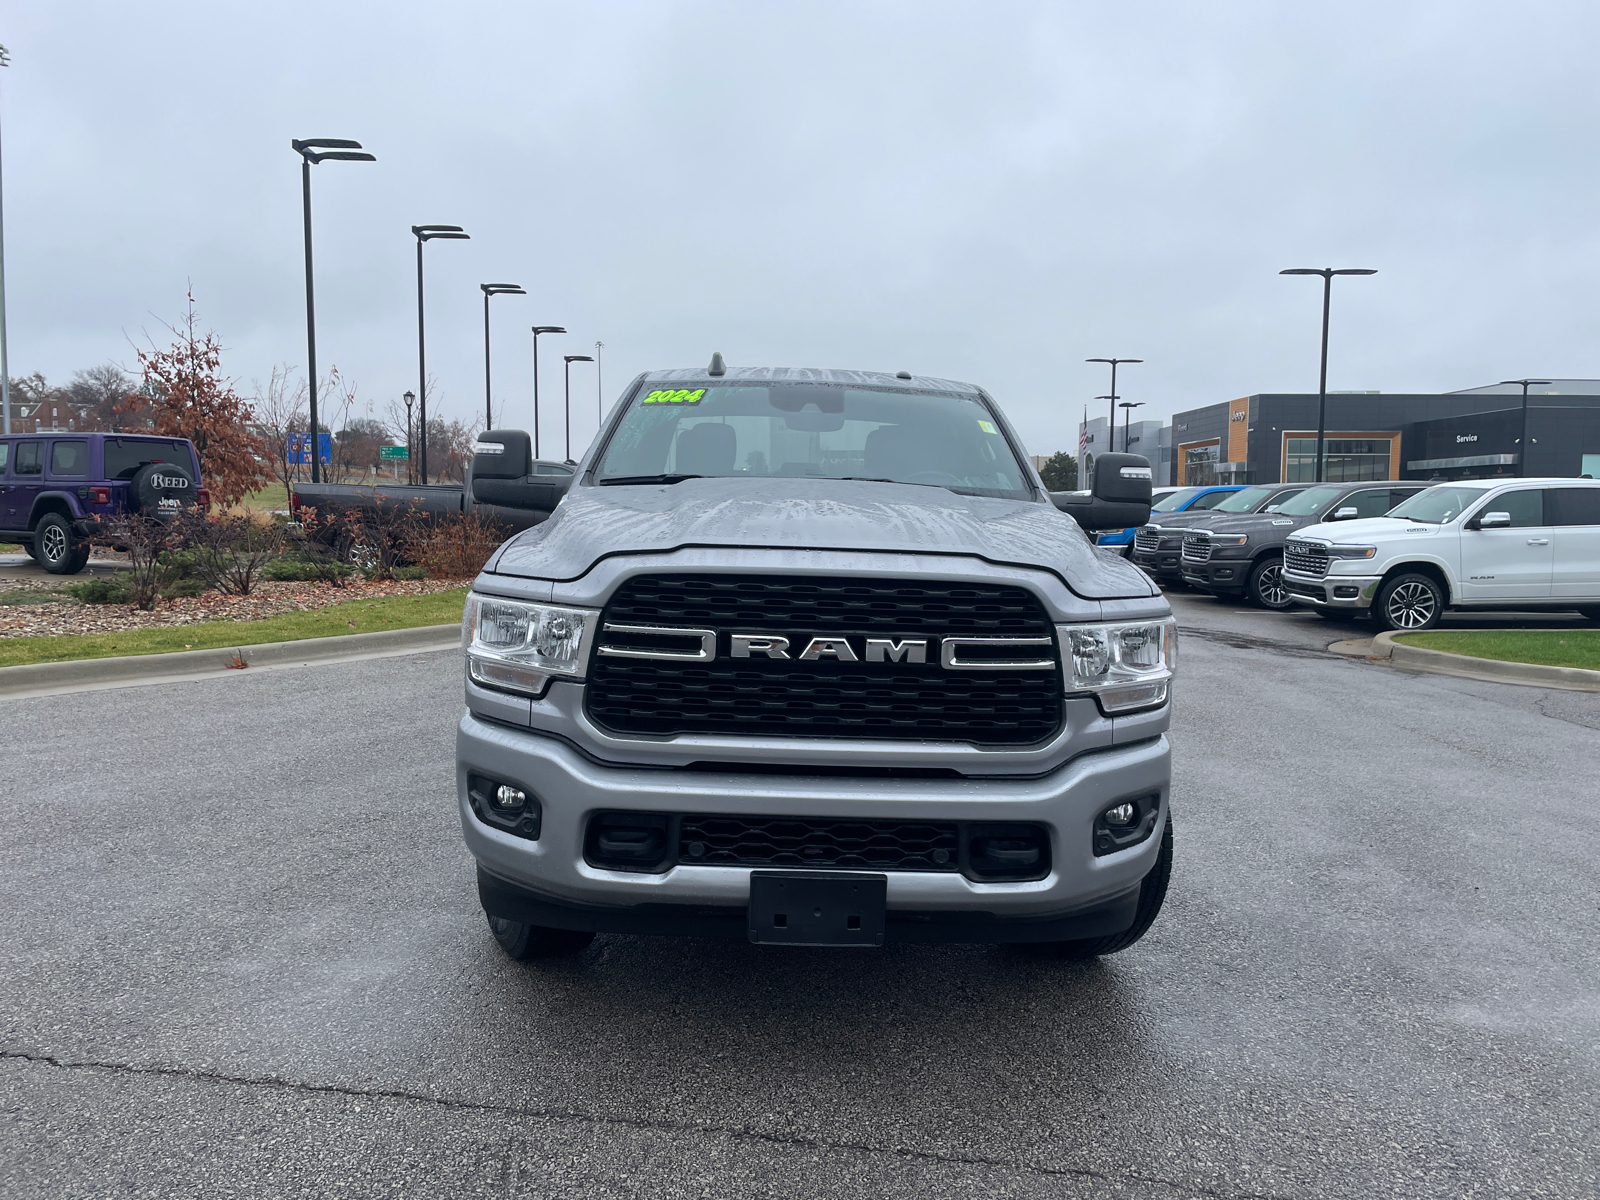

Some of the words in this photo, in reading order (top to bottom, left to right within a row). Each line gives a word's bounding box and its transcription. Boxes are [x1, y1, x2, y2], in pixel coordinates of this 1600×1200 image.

[643, 389, 706, 403] 2024
[1232, 410, 1246, 422] Jeep
[1456, 434, 1478, 443] Service
[158, 496, 181, 508] Jeep
[1288, 545, 1310, 555] RAM
[731, 634, 927, 663] RAM
